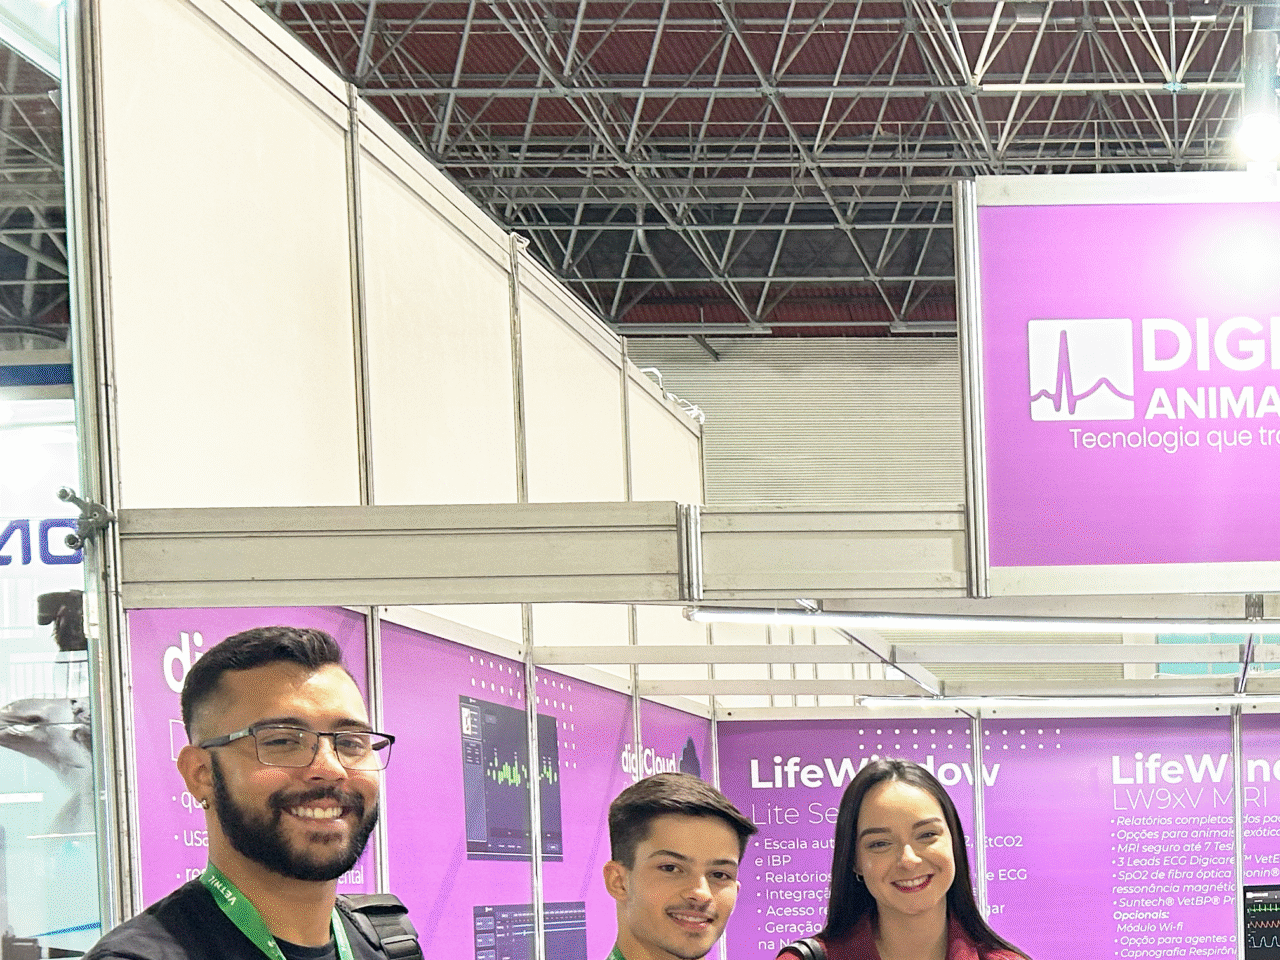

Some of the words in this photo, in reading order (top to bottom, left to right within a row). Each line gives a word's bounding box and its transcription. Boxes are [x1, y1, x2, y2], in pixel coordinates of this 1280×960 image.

[1069, 426, 1200, 453] Tecnologia
[1207, 429, 1253, 452] que
[1113, 786, 1204, 810] LW9xV
[752, 802, 800, 825] Lite
[1117, 815, 1173, 826] Relatórios
[1174, 814, 1235, 827] completos
[1117, 828, 1160, 841] Opções
[1162, 829, 1189, 841] para
[764, 837, 808, 850] Escala
[1117, 842, 1140, 853] MRI
[1142, 843, 1181, 855] seguro
[1183, 841, 1202, 852] até
[755, 857, 763, 867] e
[767, 855, 792, 867] IBP
[1117, 856, 1125, 867] 3
[1127, 856, 1161, 867] Leads
[1163, 855, 1188, 866] ECG
[998, 869, 1028, 881] ECG
[1118, 870, 1149, 882] SpO2
[1151, 869, 1166, 880] de
[1168, 868, 1194, 879] fibra
[1196, 867, 1232, 881] óptica
[208, 876, 238, 906] VETNIL
[1112, 882, 1180, 894] ressonância
[765, 905, 815, 917] Acesso
[765, 920, 823, 936] Geração
[1116, 921, 1157, 933] Módulo
[1159, 921, 1184, 932] Wi-fi
[758, 940, 775, 950] na
[1120, 935, 1156, 947] Opção
[1157, 935, 1183, 946] para
[1185, 933, 1228, 946] agentes
[1120, 946, 1187, 959] Capnografia
